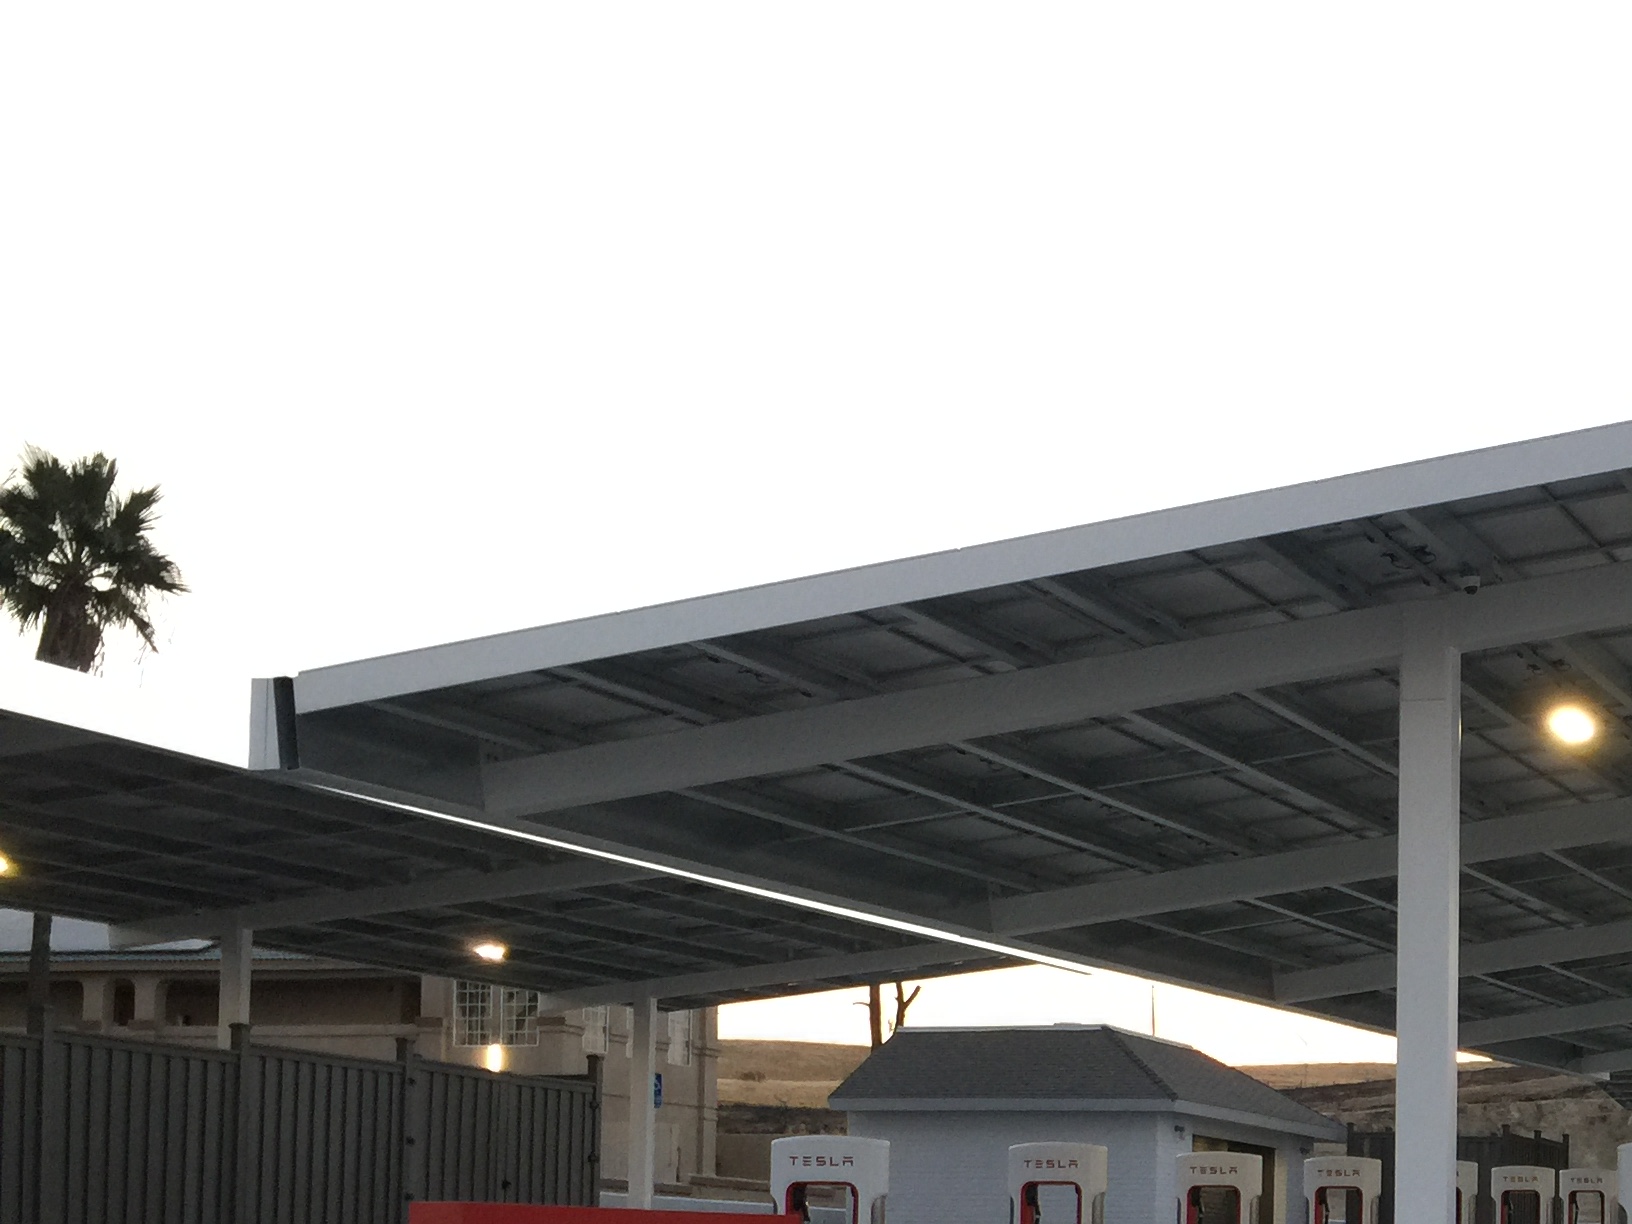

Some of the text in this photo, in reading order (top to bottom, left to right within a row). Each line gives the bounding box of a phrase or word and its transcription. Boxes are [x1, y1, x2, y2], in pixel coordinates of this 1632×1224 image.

[788, 1155, 854, 1167] TESLA
[1023, 1159, 1079, 1169] TESLA
[1189, 1165, 1238, 1175] TESLA
[1317, 1168, 1361, 1177] TESLA
[1502, 1175, 1539, 1183] TESLA
